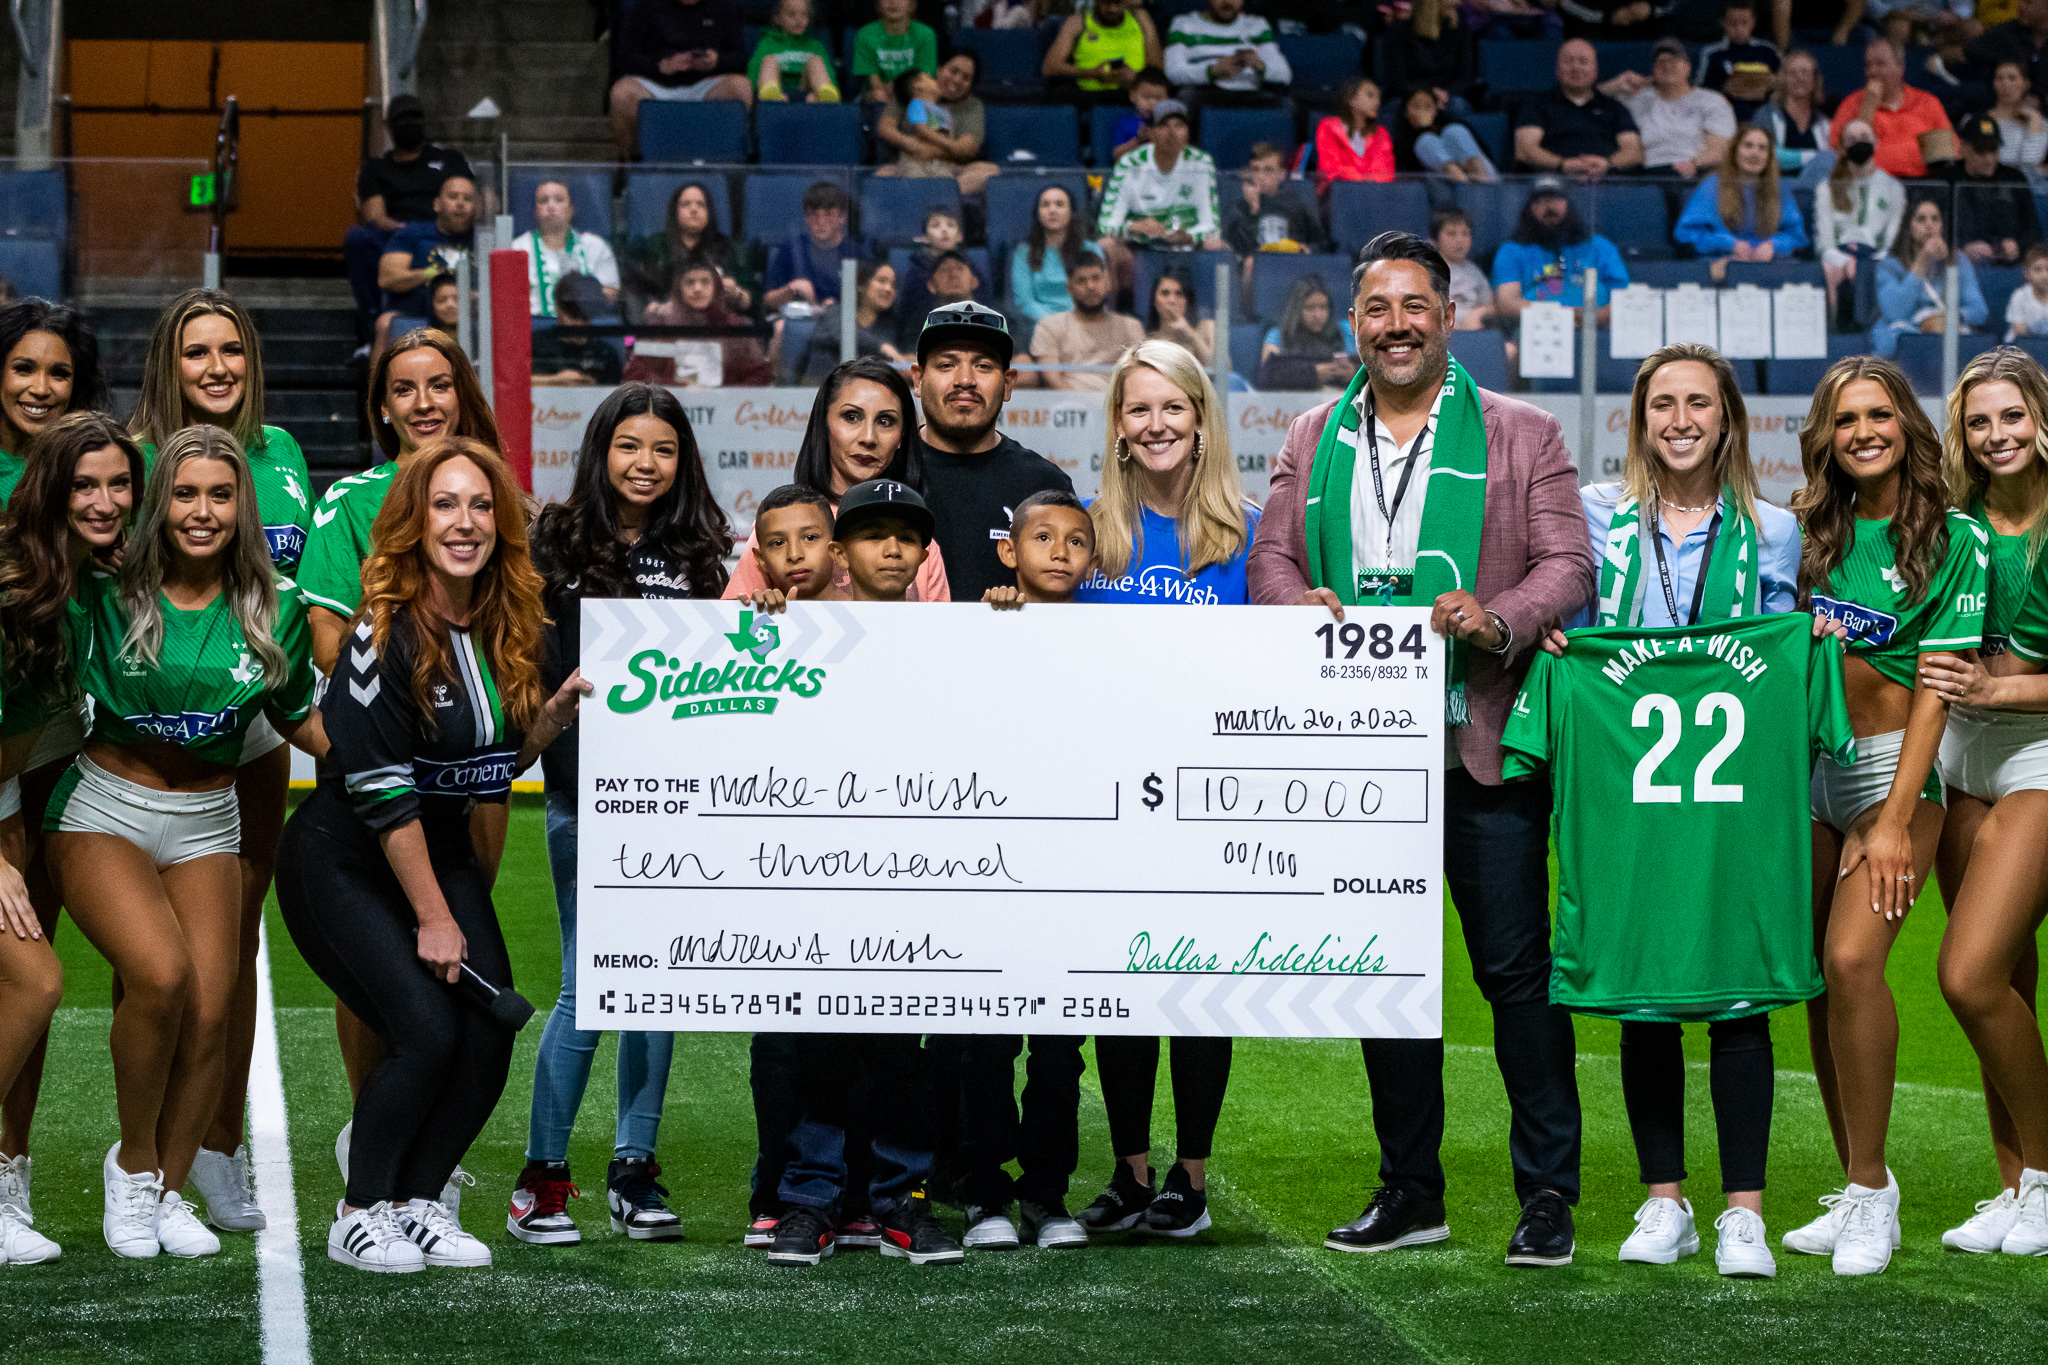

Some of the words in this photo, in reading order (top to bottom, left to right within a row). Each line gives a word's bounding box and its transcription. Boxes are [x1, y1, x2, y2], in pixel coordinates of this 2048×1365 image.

[1007, 409, 1050, 428] WRAP
[1054, 410, 1087, 428] CITY
[532, 450, 569, 469] RAP
[719, 451, 748, 470] CAR
[752, 451, 797, 470] WRAP
[1237, 454, 1266, 473] CAR
[639, 557, 665, 568] 1987
[1315, 623, 1427, 660] 1984
[1601, 634, 1768, 686] MAKE-A-WISH
[607, 649, 827, 714] Sidekicks
[1320, 665, 1408, 681] 86-2356/8932
[1414, 666, 1428, 680] TX
[690, 700, 766, 715] DALLAS
[1215, 705, 1296, 733] march
[1303, 708, 1342, 732] 26,
[1350, 708, 1418, 730] 2022
[1631, 691, 1745, 803] 22
[435, 761, 516, 788] Comeric
[595, 778, 630, 793] PAY
[634, 778, 660, 793] TO
[664, 778, 700, 793] THE
[1141, 772, 1164, 812] $
[1205, 776, 1383, 818] 10,000
[595, 800, 658, 815] ORDER
[663, 800, 690, 815] OF
[612, 843, 724, 881] ten
[749, 842, 1023, 884] thousand
[1223, 841, 1297, 878] 00/100
[1333, 878, 1427, 895] DOLLARS
[850, 930, 963, 964] wish
[1126, 931, 1222, 972] Dallas
[1231, 931, 1389, 975] Sidekicks
[593, 954, 659, 969] MEMO:
[1062, 997, 1130, 1019] 2586
